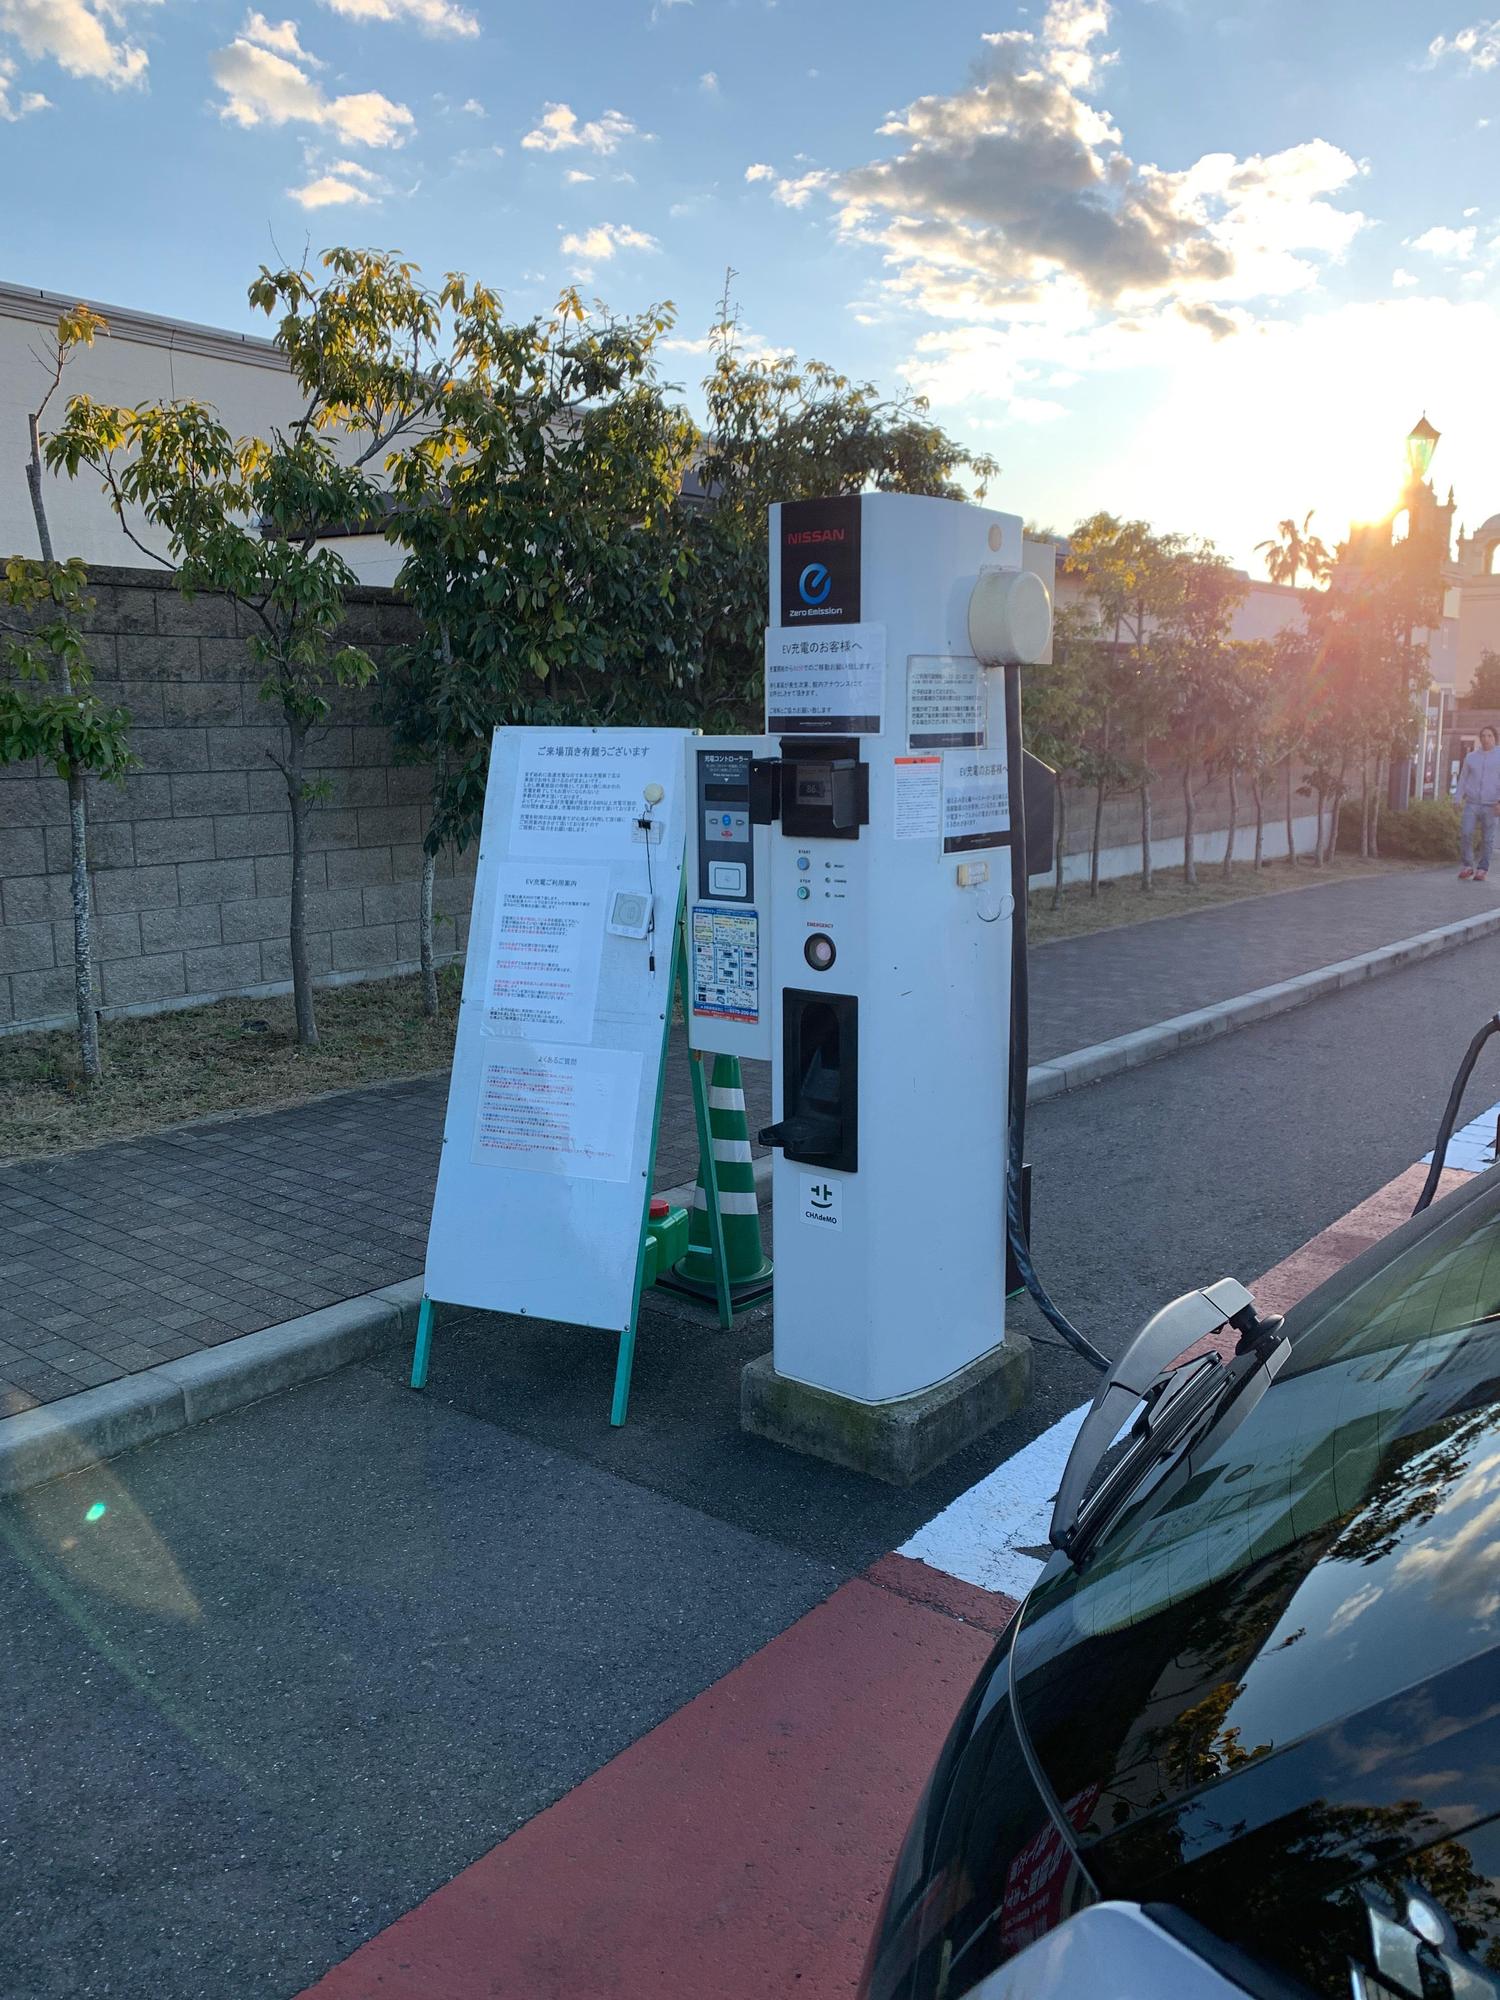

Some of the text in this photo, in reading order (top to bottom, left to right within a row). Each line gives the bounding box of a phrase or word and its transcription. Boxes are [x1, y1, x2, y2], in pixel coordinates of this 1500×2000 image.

[787, 528, 845, 545] NISSAN
[789, 607, 843, 617] Zero Emission
[782, 641, 863, 655] EV充電のお客様へ
[537, 745, 650, 758] ご来場頂き有難うございます
[525, 878, 577, 887] EV充電ご利用案内
[537, 1055, 577, 1066] よくあるご質問
[805, 1210, 838, 1224] CHAdeMO
